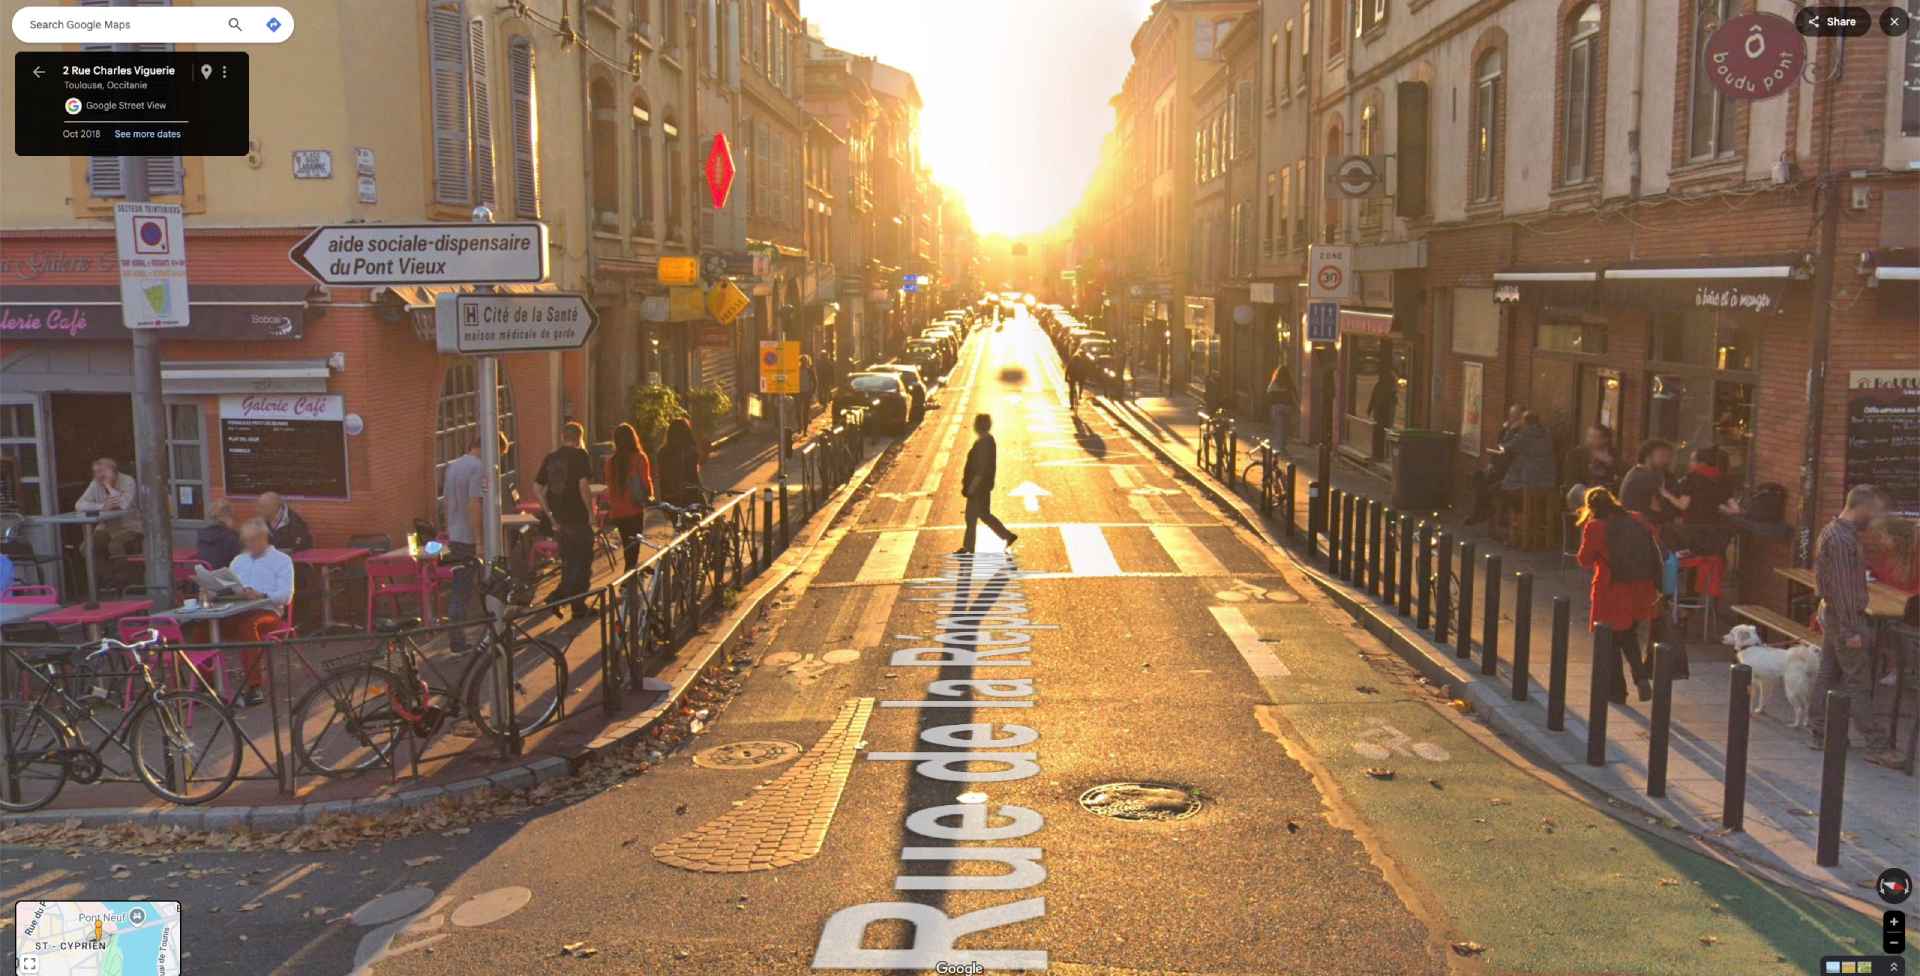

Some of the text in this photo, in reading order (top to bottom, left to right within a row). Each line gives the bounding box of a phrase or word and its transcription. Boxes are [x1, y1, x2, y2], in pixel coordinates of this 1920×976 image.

[1713, 51, 1793, 92] boudu pont
[328, 234, 531, 256] aide sociale-dispensaire
[330, 257, 447, 275] du Pont Vieux
[1730, 287, 1738, 307] à
[0, 308, 87, 336] lerie Café
[466, 305, 578, 324] H Cité de la Santé
[464, 328, 576, 341] maison médicale de garde
[241, 395, 327, 417] Galerie Café
